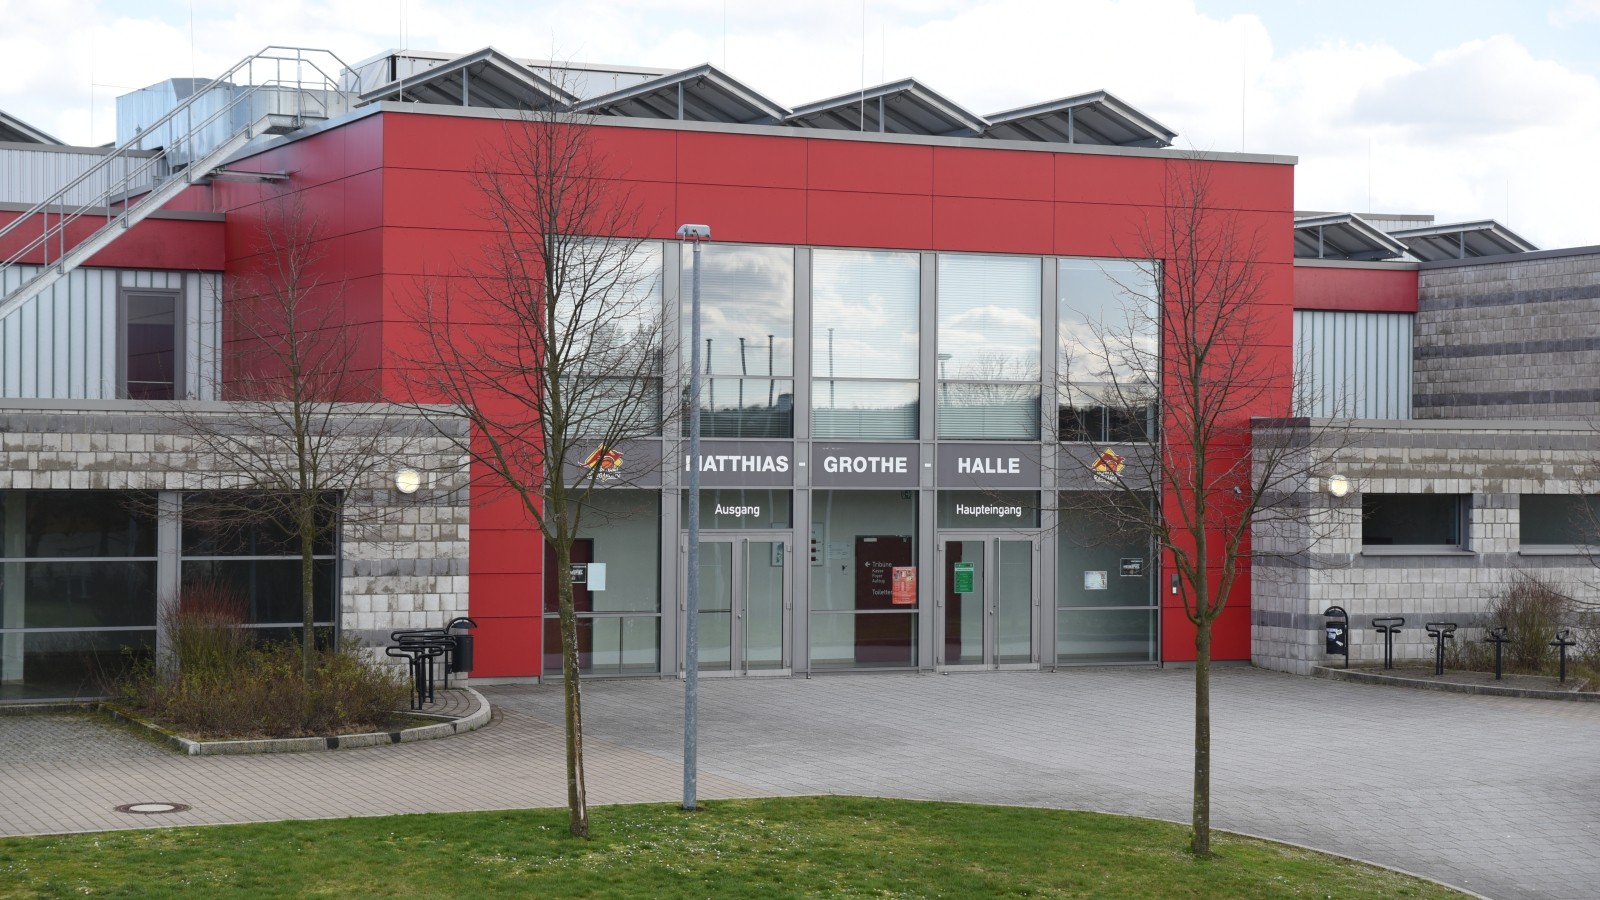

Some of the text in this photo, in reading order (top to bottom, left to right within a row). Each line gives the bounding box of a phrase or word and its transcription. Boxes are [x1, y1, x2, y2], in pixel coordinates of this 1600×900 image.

[823, 456, 908, 473] GROTHE
[957, 457, 1020, 474] HALLE
[714, 503, 760, 518] Ausgang
[955, 503, 1022, 517] Haupteingang
